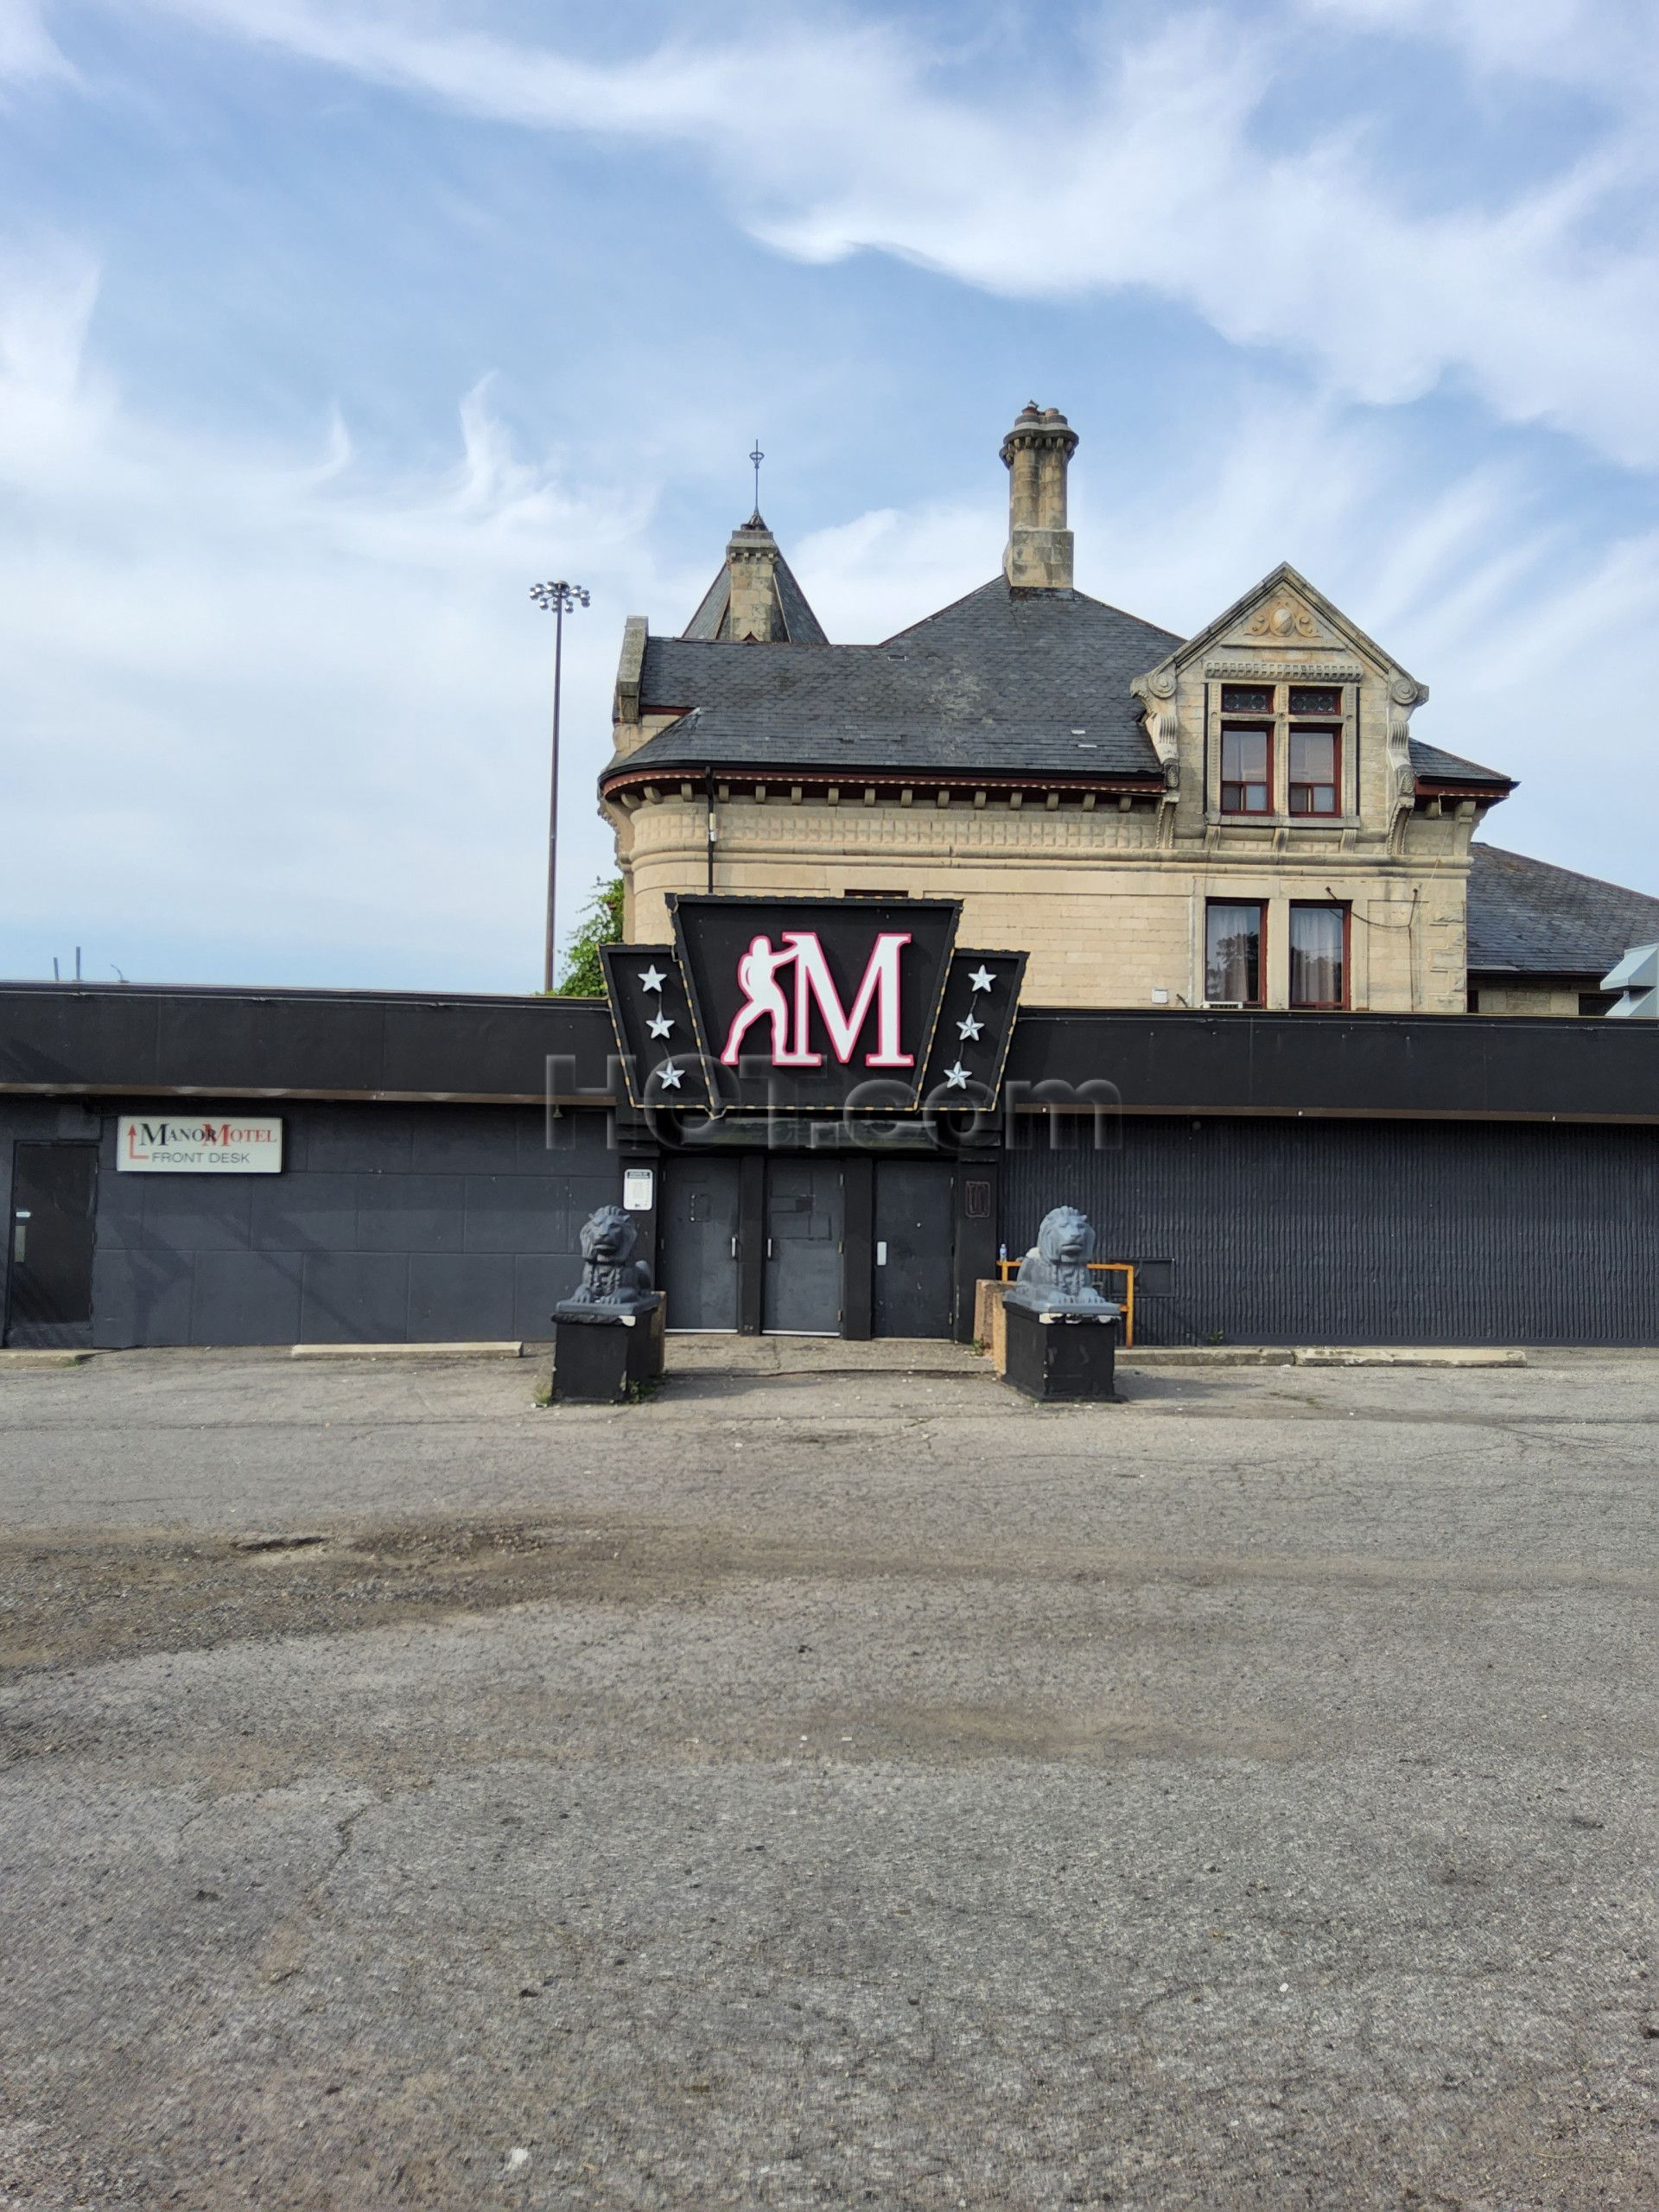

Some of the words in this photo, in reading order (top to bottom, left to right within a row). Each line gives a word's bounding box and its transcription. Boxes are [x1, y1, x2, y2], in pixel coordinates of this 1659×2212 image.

[772, 932, 914, 1066] M
[151, 1152, 205, 1164] FRONT
[208, 1153, 251, 1164] DESK
